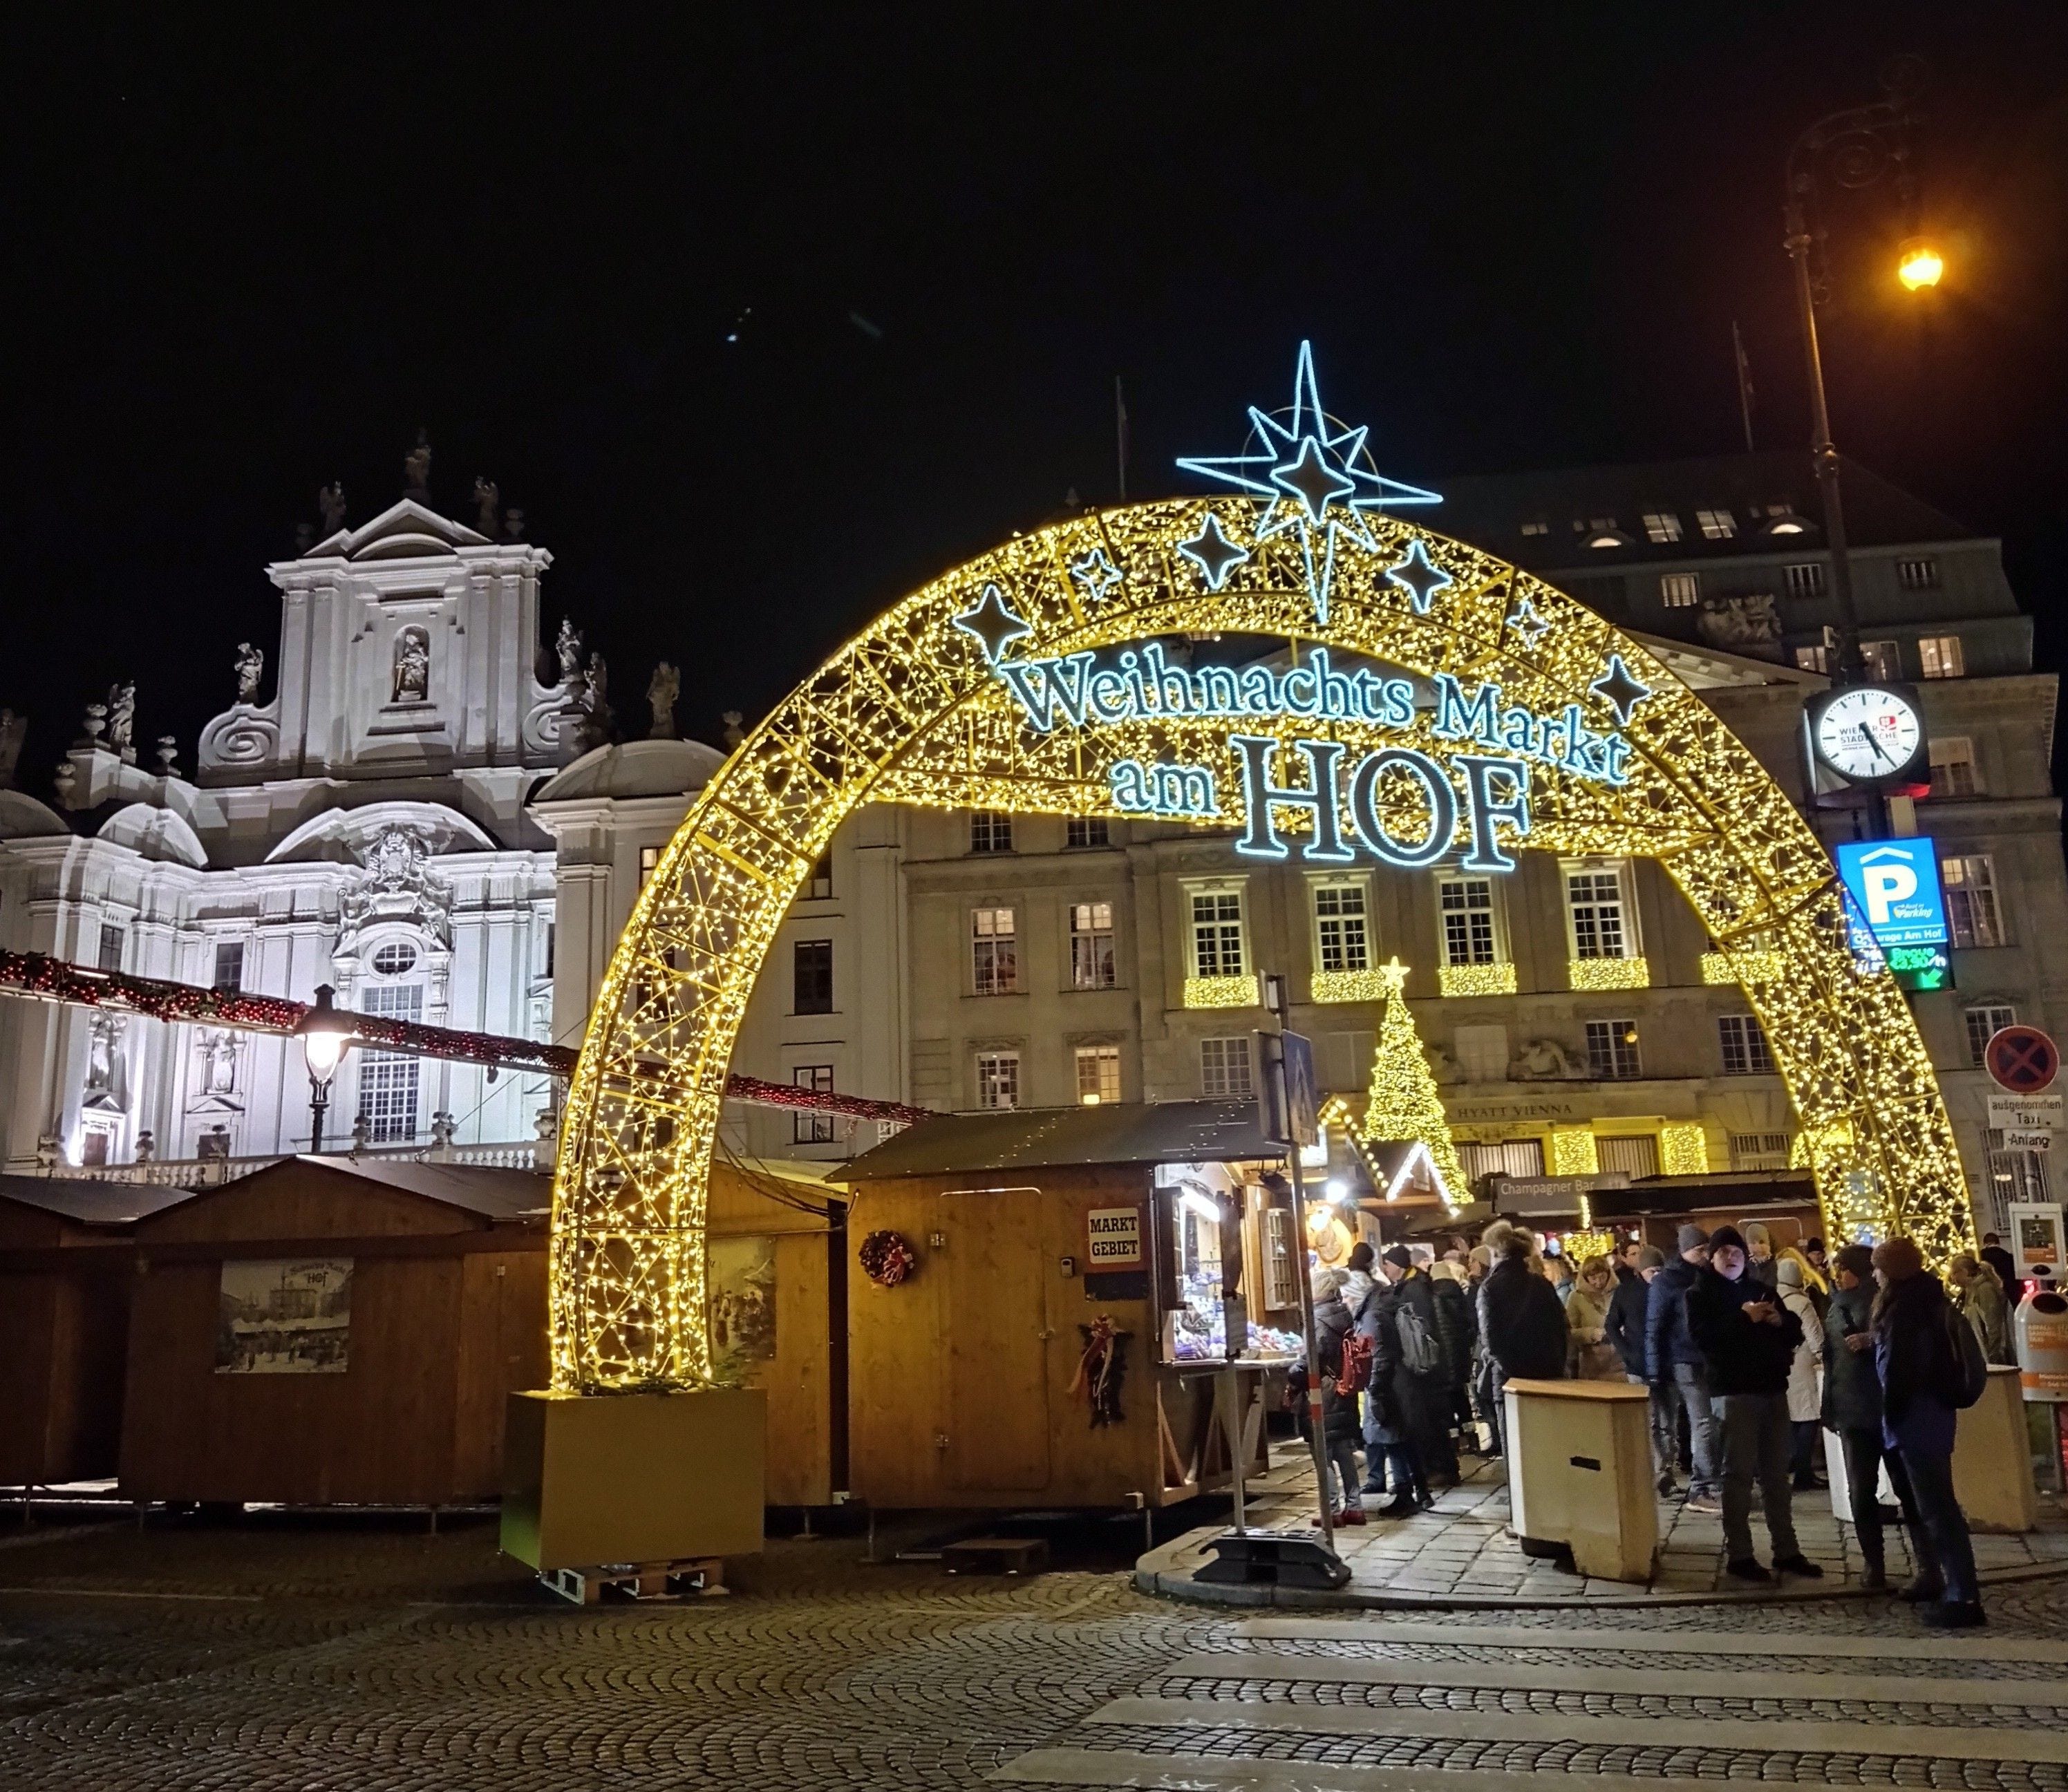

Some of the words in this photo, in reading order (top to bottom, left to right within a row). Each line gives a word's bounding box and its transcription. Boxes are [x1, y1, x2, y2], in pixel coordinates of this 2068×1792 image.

[997, 643, 1415, 732] Weihnachts
[1431, 672, 1631, 786] Markt
[1109, 757, 1220, 816] am
[1230, 734, 1531, 872] HOF
[1863, 864, 1918, 923] P
[1904, 931, 1921, 940] Am
[1924, 929, 1942, 939] Hof
[1457, 1106, 1507, 1118] HYATT
[1513, 1104, 1572, 1115] VIENNA
[2015, 1113, 2041, 1124] Taxi
[2009, 1133, 2050, 1149] Anfang
[1501, 1182, 1572, 1196] Champagner
[1575, 1179, 1595, 1191] Bar
[1090, 1216, 1137, 1234] MARKT
[1092, 1240, 1138, 1256] GEBIET
